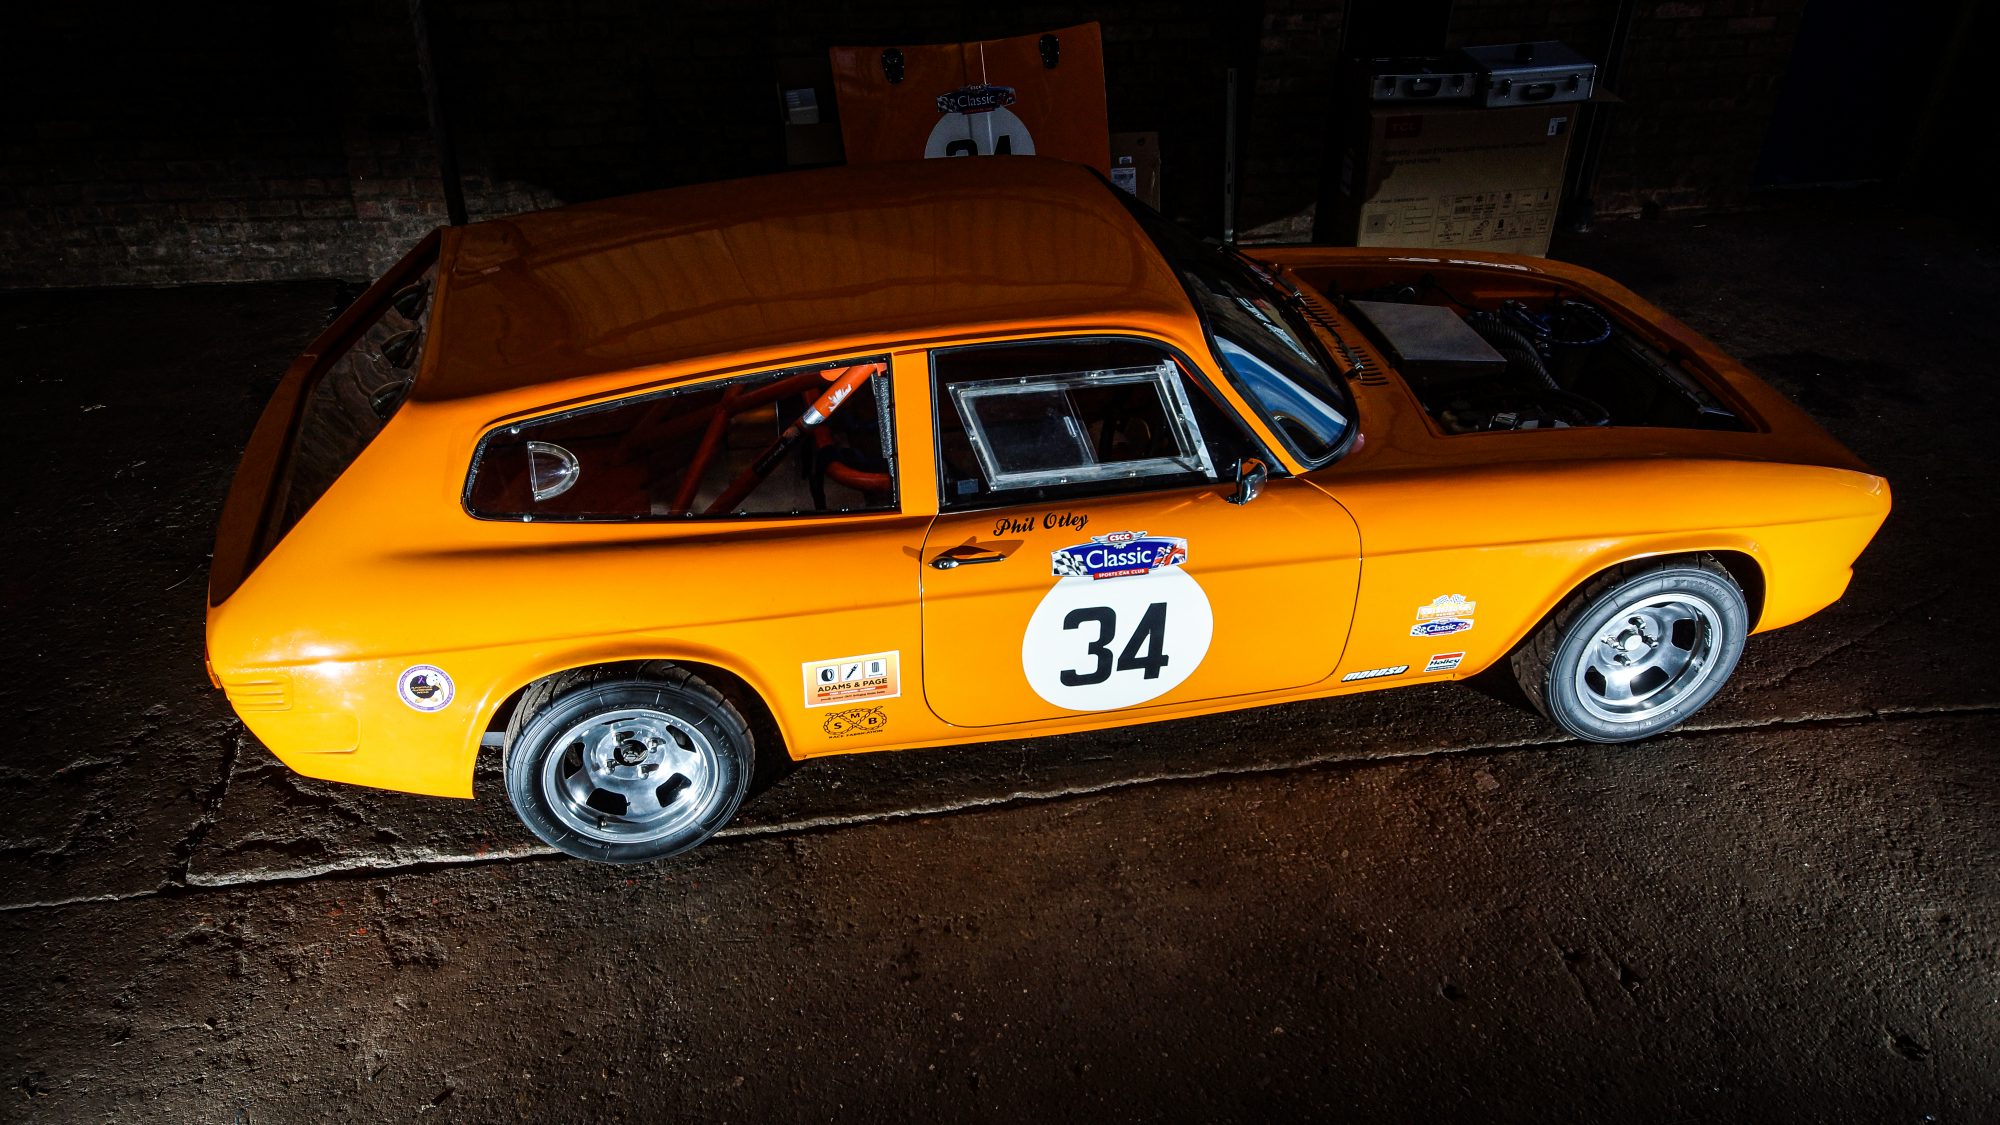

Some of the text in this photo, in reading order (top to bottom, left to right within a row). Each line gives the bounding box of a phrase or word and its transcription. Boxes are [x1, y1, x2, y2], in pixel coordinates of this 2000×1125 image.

[957, 94, 996, 107] Classic
[1391, 122, 1417, 132] TCL
[993, 512, 1089, 537] Phil Otley
[1109, 533, 1131, 541] CSCC
[1086, 547, 1152, 569] Classic
[1098, 570, 1118, 578] SPORTS
[1426, 623, 1456, 632] Classic
[1060, 602, 1169, 687] 34
[1429, 658, 1461, 666] Holley
[818, 682, 852, 692] ADAMS
[863, 678, 888, 686] PAGE
[834, 722, 842, 730] S
